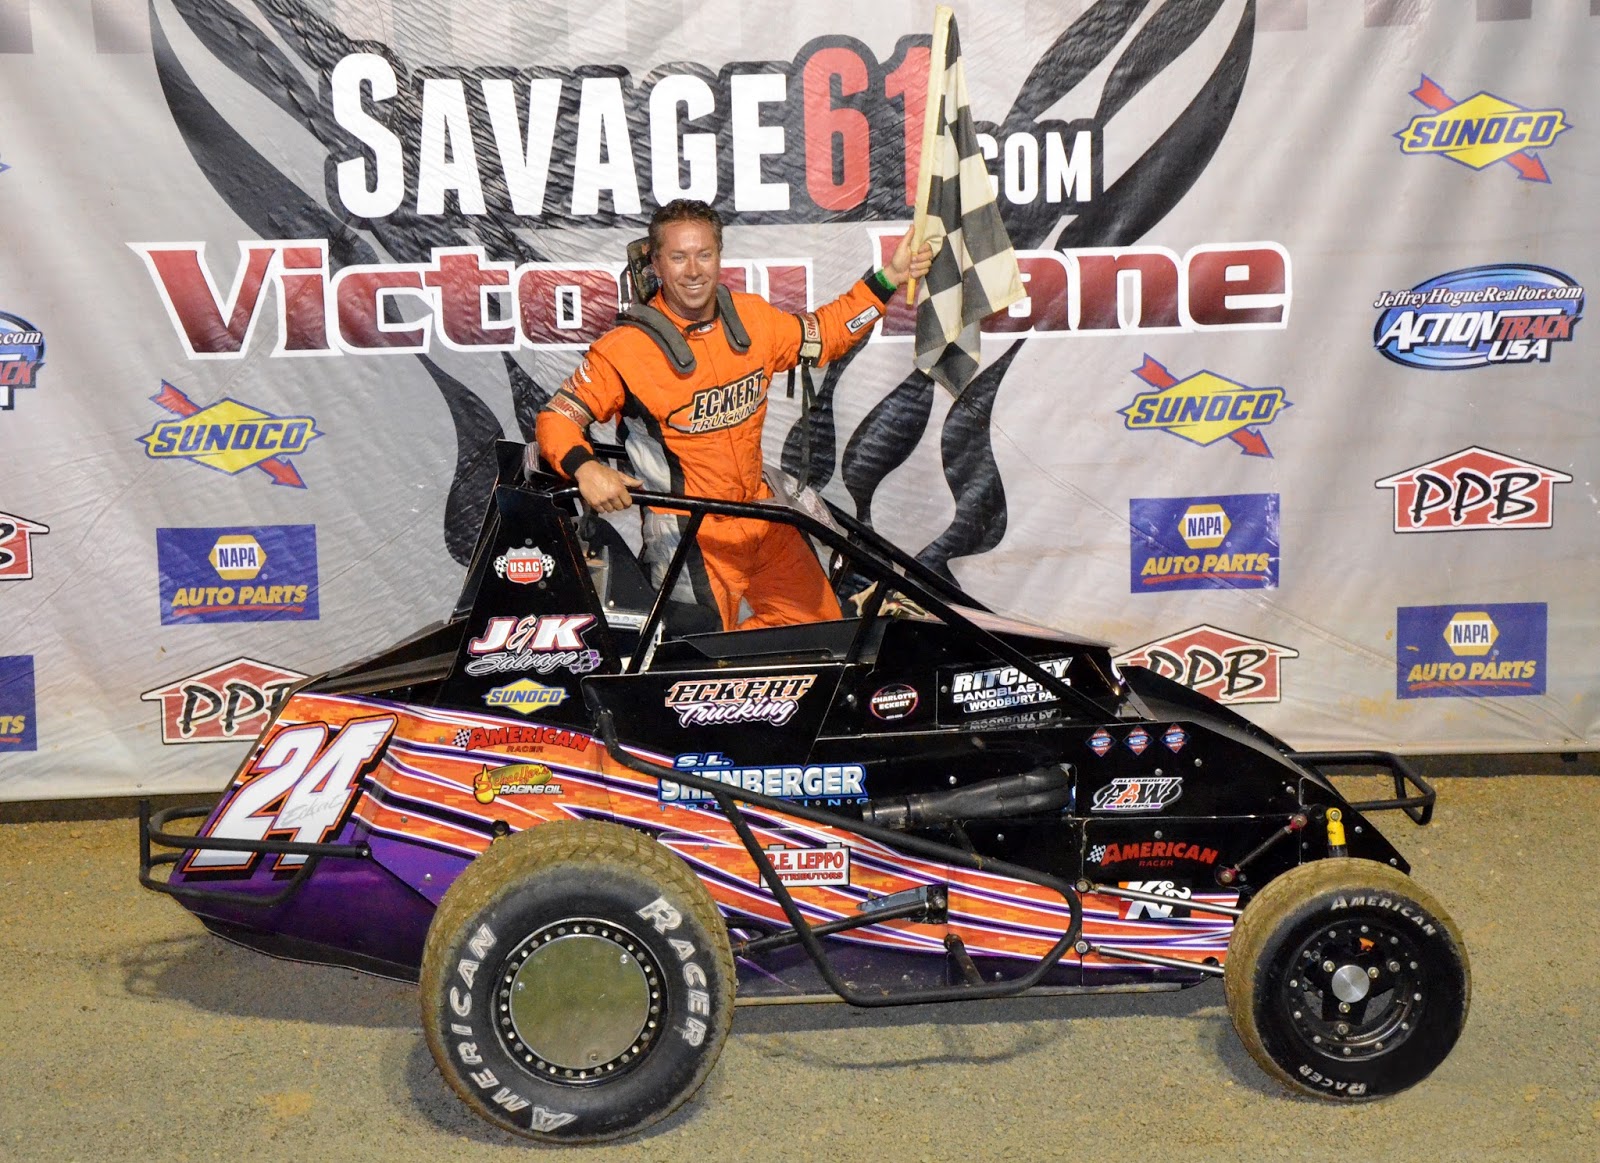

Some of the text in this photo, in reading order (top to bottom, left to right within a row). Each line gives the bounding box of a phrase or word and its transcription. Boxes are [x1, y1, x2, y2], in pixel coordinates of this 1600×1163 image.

[331, 47, 1093, 220] SAVAGE61OM
[1408, 114, 1557, 149] SUNOCO
[127, 238, 813, 361] Victo
[1374, 285, 1584, 309] JeffreyHogueRealtor.com
[1377, 309, 1576, 350] ACTION TRACK
[1487, 339, 1548, 361] USA
[693, 372, 764, 421] ECKERT
[1133, 393, 1276, 424] SUNOCO
[153, 422, 308, 452] SUNOCO
[1411, 472, 1540, 524] PPB
[1187, 515, 1223, 537] NAPA
[218, 547, 257, 568] NAPA
[509, 561, 540, 573] USAC
[1141, 553, 1269, 576] AUTO PARTS
[171, 585, 308, 607] AUTO PARTS
[470, 614, 596, 653] J&K
[1452, 624, 1490, 646] NAPA
[465, 650, 578, 676] Salvage
[1408, 659, 1536, 682] AUTO PARTS
[489, 689, 562, 703] SUNOCO
[667, 676, 816, 706] ECKERT
[871, 692, 917, 704] CHARLOTTE
[969, 691, 1057, 711] WOODBURY PA.
[674, 697, 797, 727] Trucking
[879, 700, 910, 710] ECKERT
[466, 726, 591, 752] AMERICAN
[506, 745, 544, 753] RACER
[676, 754, 731, 768] S.L.
[186, 714, 398, 870] 24
[500, 784, 563, 795] RACING OIL
[797, 851, 844, 870] LEPPO
[1101, 841, 1219, 867] AMERICAN
[1330, 896, 1437, 936] AMERICAN
[636, 896, 710, 1048] RACER
[449, 922, 578, 1133] AMERICAN
[1298, 1064, 1368, 1095] RACER
